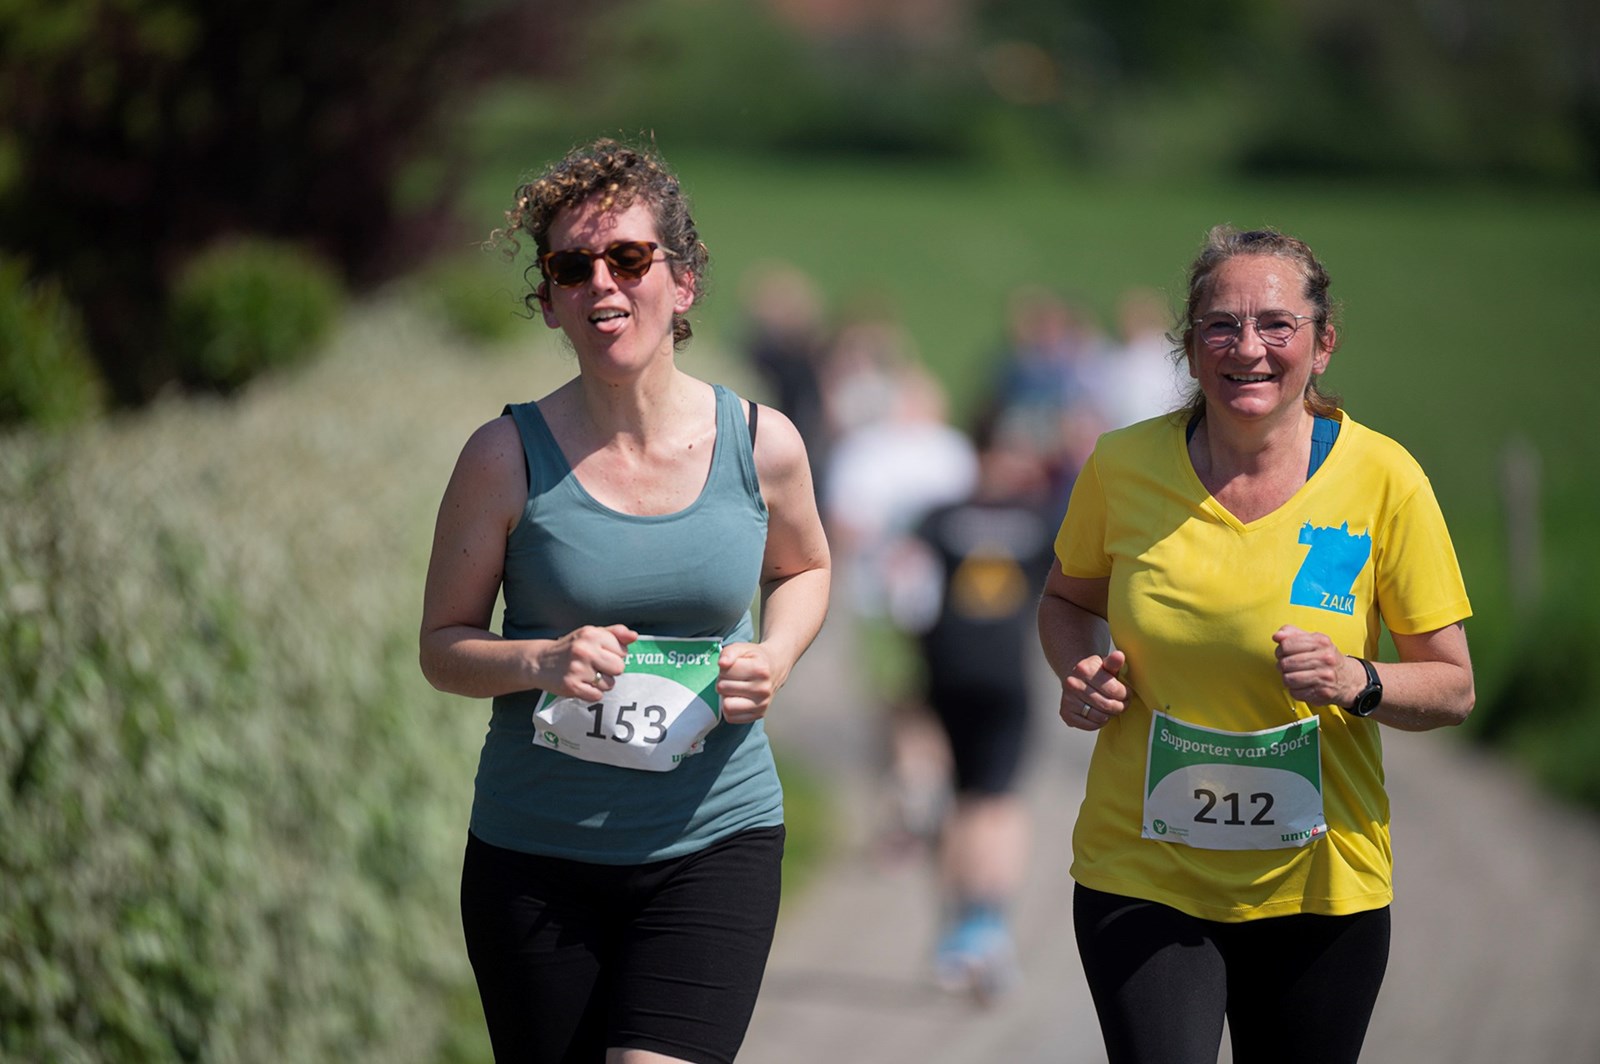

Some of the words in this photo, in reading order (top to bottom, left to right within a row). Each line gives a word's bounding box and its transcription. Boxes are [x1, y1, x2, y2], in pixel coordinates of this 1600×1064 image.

[1320, 591, 1353, 612] ZALK
[637, 653, 664, 665] van
[667, 651, 711, 668] Sport
[586, 702, 667, 744] 153
[1160, 728, 1231, 758] Supporter
[1235, 745, 1267, 758] van
[1270, 734, 1310, 757] Sport
[1193, 788, 1275, 826] 212
